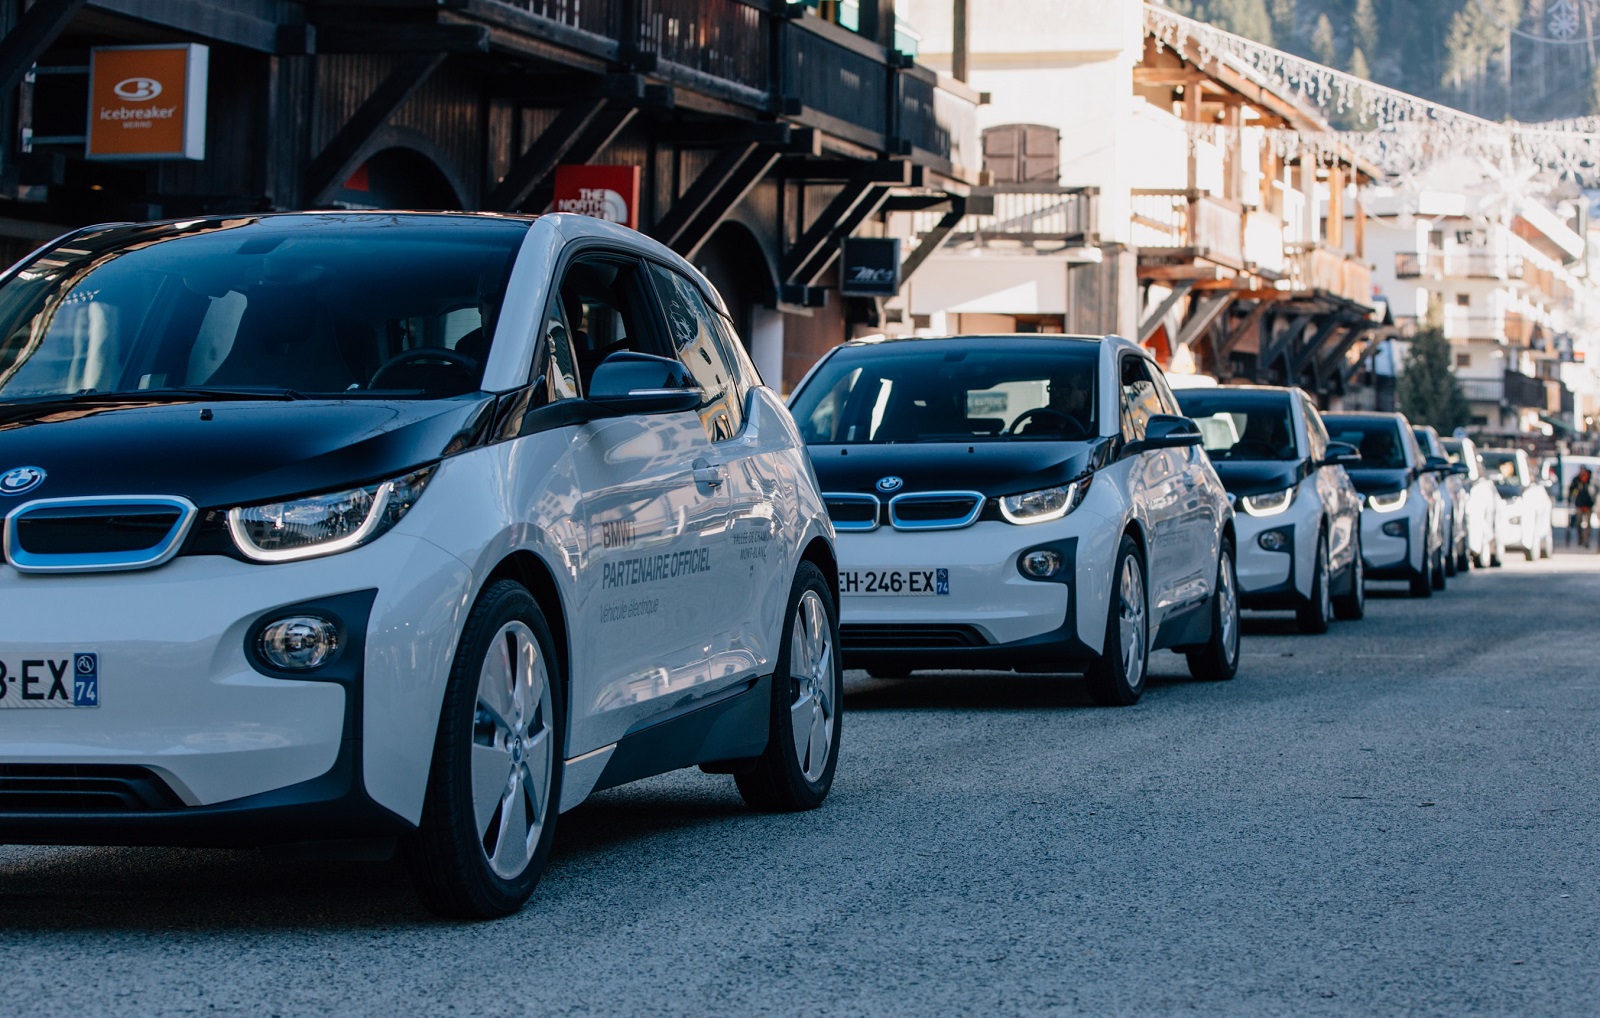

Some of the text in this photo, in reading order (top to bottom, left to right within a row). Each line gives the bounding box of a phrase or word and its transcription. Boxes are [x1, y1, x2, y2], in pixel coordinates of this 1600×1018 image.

[100, 105, 176, 120] icebreaker
[579, 188, 605, 200] THE
[558, 199, 605, 212] NORTH
[602, 520, 630, 549] BMW
[602, 547, 711, 590] PARTENAIRE OFFICIEL
[937, 582, 948, 592] 74
[75, 681, 96, 701] 74
